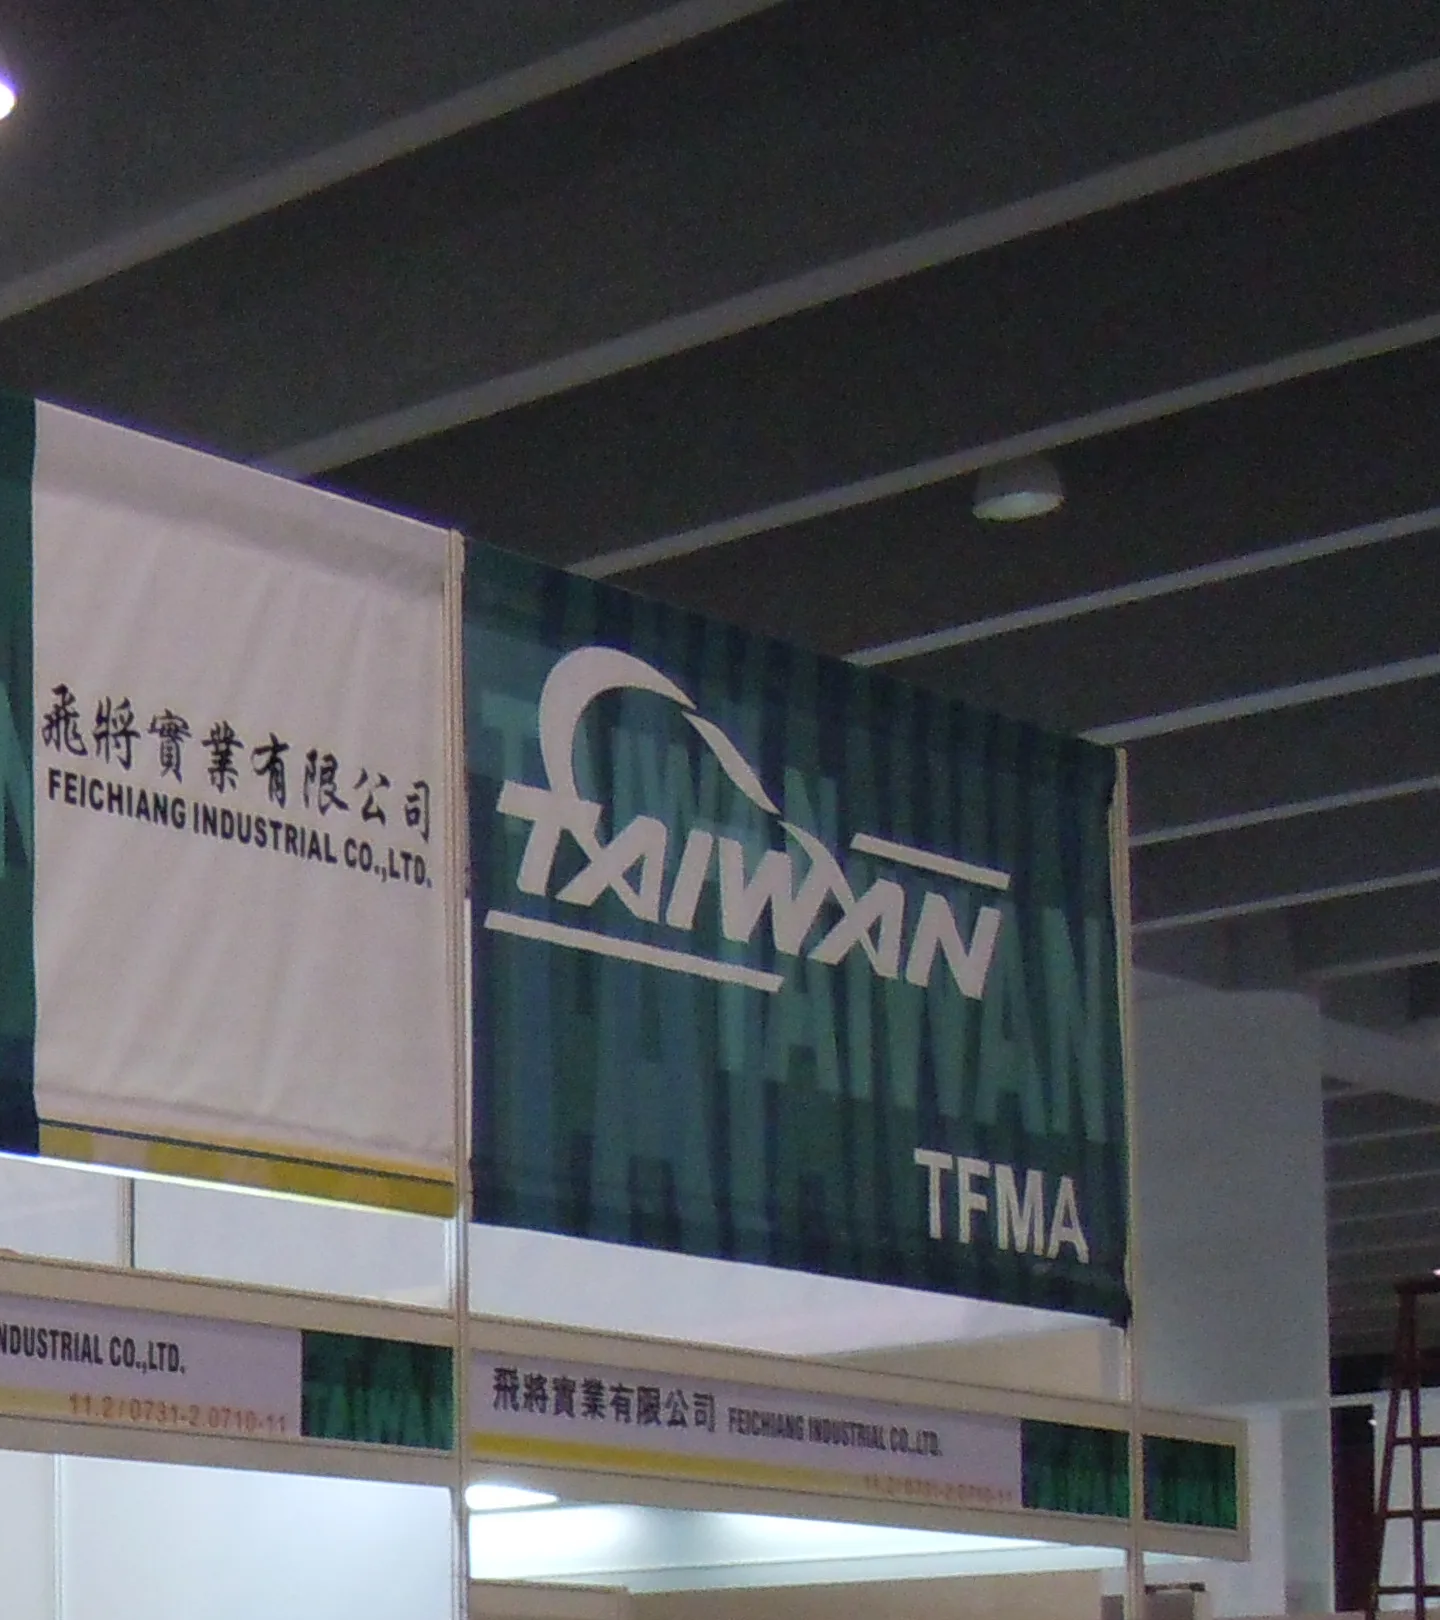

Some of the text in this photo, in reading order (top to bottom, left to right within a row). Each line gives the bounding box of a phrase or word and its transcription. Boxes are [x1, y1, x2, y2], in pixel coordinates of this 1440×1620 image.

[41, 683, 431, 843] 飛將實業有限公司
[47, 767, 433, 888] FEICHIANG INDUSTRIAL CO.,LTD.
[495, 780, 1002, 1000] TAIWAN
[912, 1147, 1090, 1264] TFMA
[109, 1335, 185, 1375] CO.,LTD.
[808, 1414, 887, 1451] INDUSTRIAL
